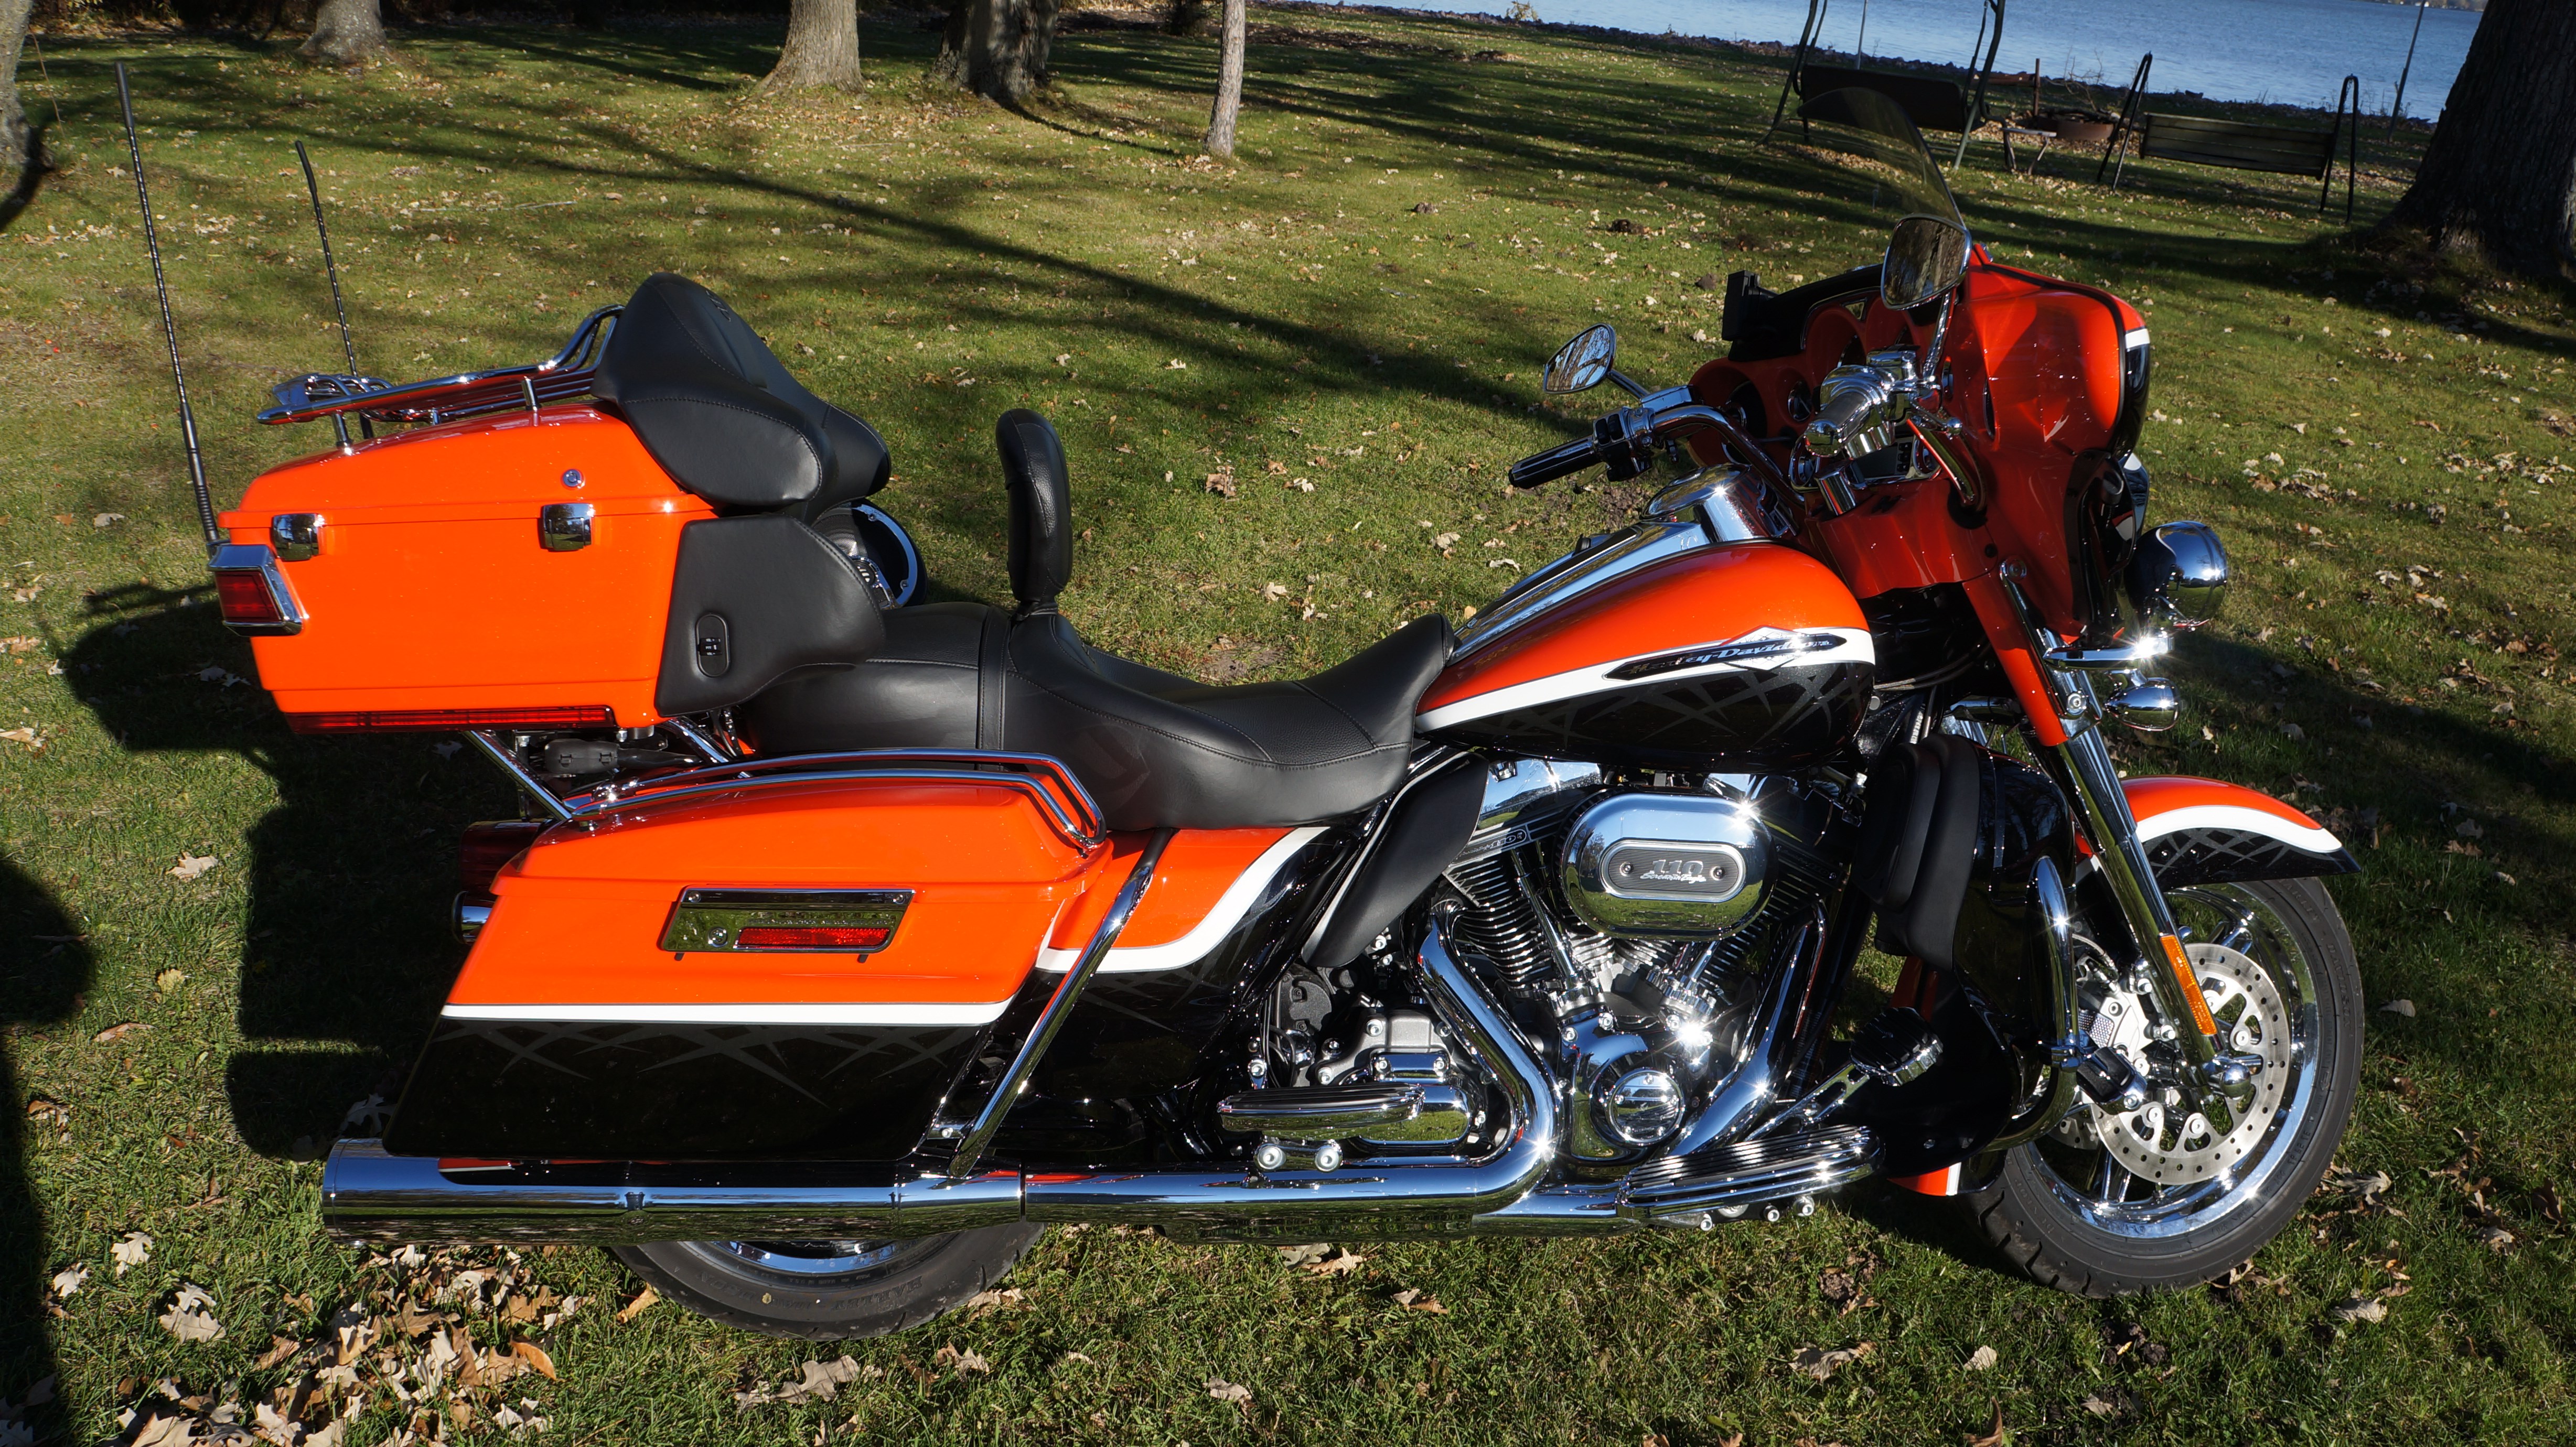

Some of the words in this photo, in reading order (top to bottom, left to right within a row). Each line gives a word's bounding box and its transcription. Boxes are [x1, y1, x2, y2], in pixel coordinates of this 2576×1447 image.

[1621, 640, 1832, 675] Harley-Davidon
[1652, 859, 1703, 876] 110
[831, 1276, 923, 1311] HARLEY
